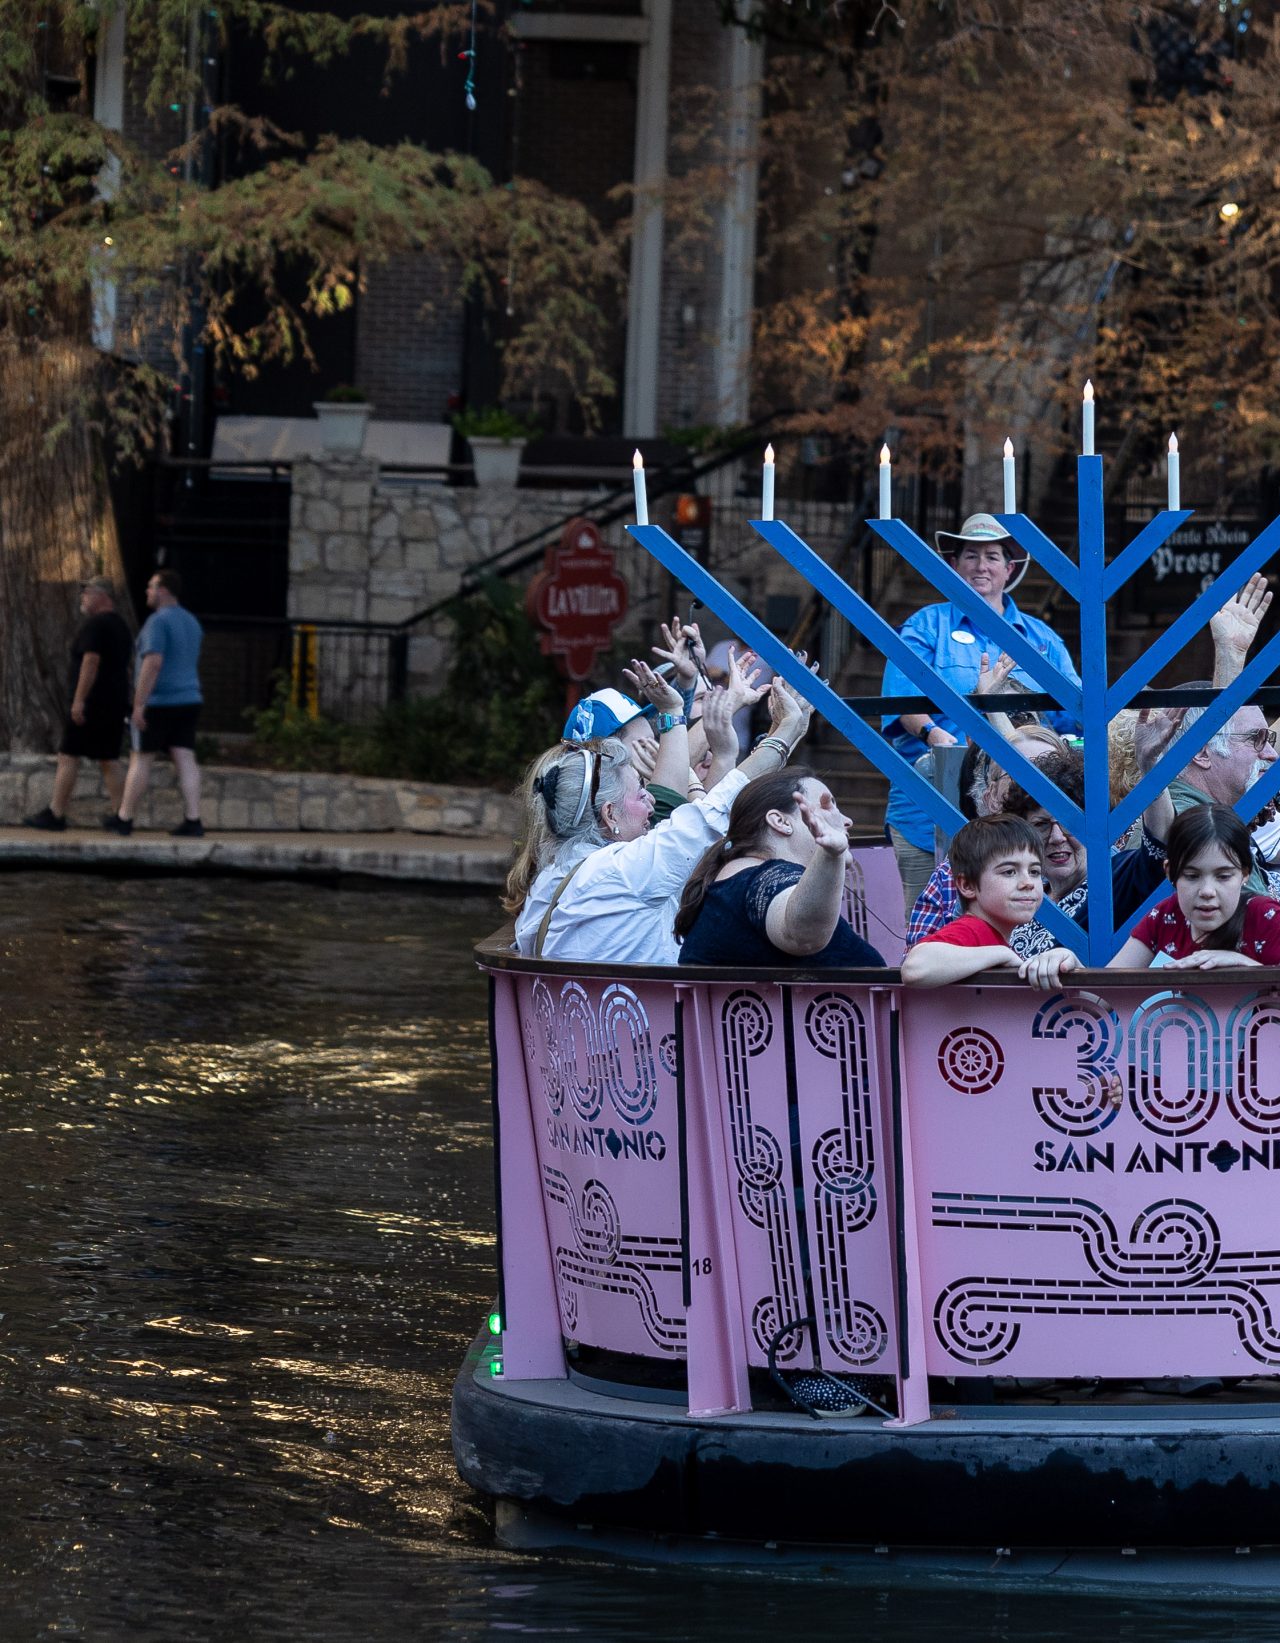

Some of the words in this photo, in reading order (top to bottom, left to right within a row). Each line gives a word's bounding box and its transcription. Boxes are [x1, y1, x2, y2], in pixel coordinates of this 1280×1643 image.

[1151, 546, 1221, 583] Prost
[531, 976, 658, 1126] 300
[547, 1117, 571, 1151] SAN
[573, 1126, 667, 1162] ANTONIO
[1032, 1140, 1115, 1173] SAN
[692, 1257, 713, 1276] 18
